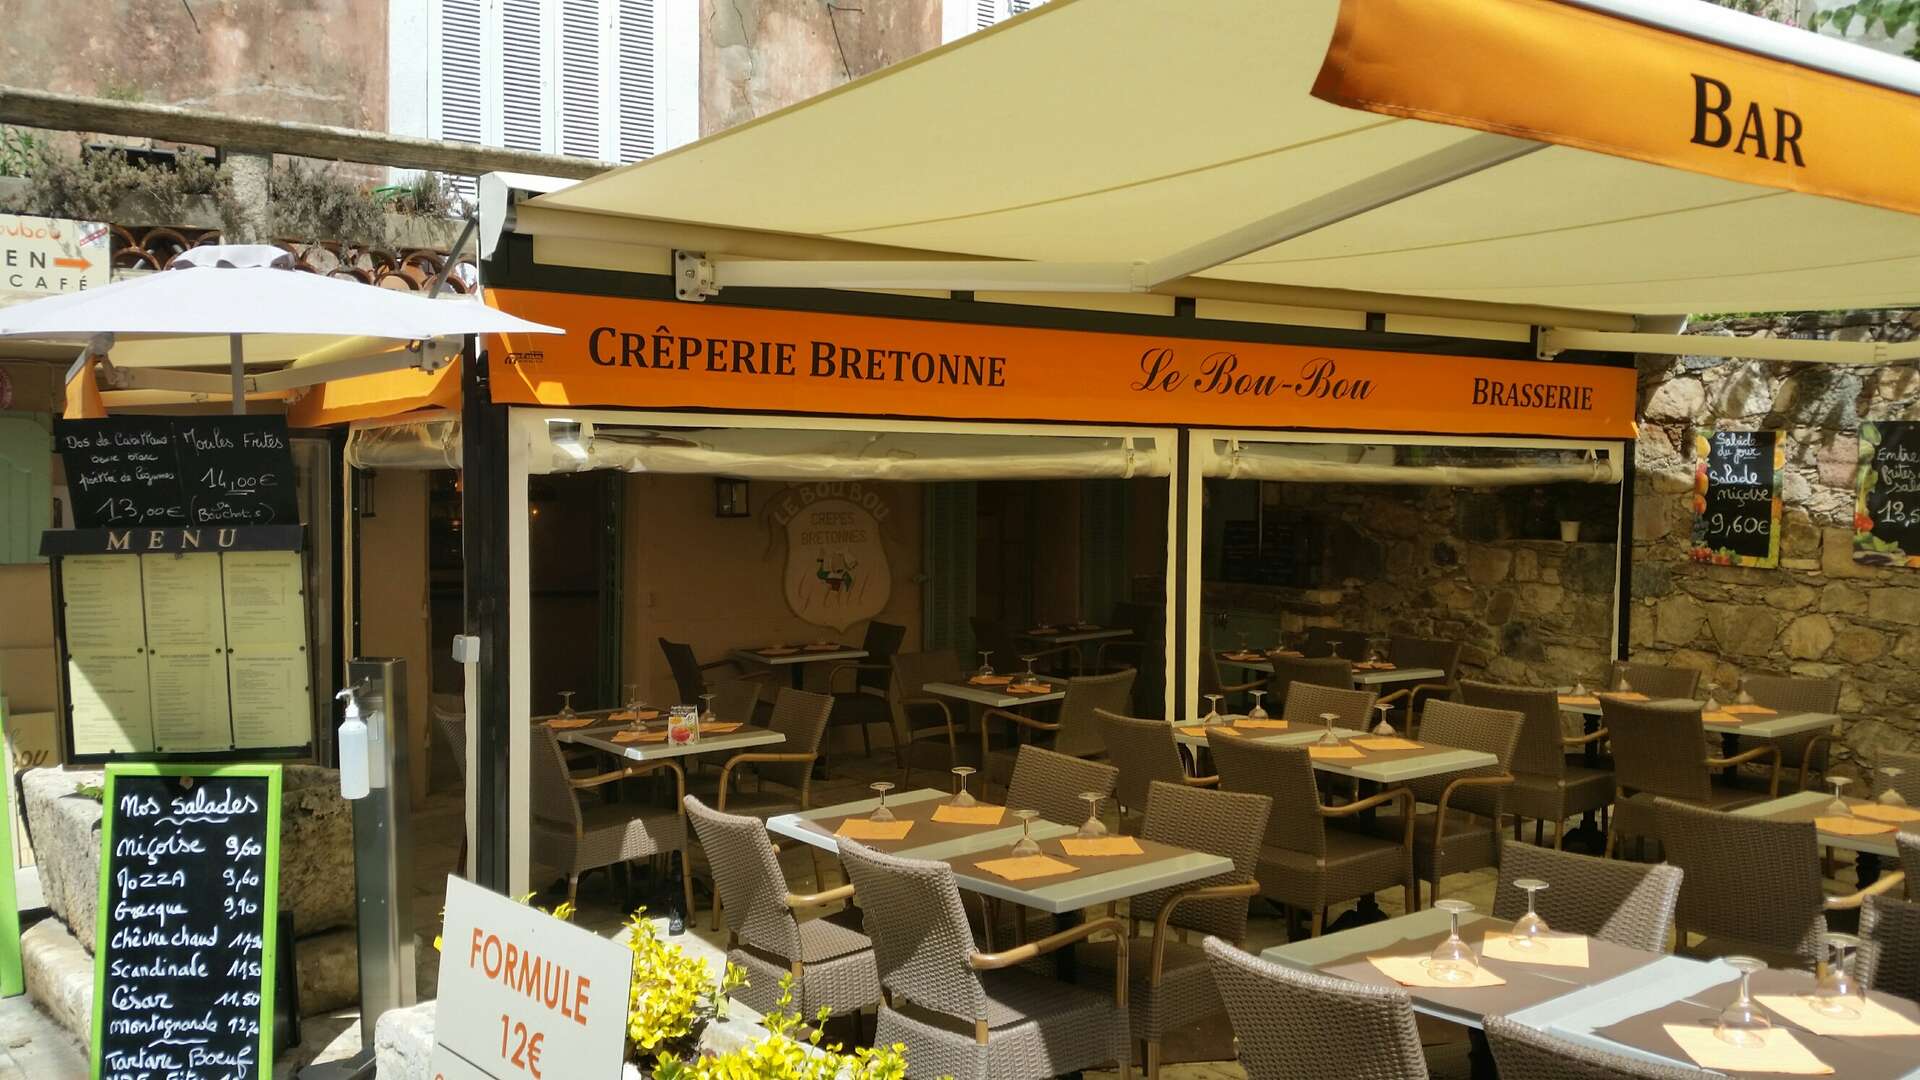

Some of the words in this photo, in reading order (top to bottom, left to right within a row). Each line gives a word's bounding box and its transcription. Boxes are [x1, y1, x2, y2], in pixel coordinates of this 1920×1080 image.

[1690, 73, 1806, 168] BAR
[9, 274, 88, 291] CAFÉ
[588, 325, 797, 377] CRÊPERIE
[809, 340, 1007, 387] BRETONNE
[1130, 347, 1189, 393] Le
[1194, 351, 1377, 400] Bou-Bou
[1472, 377, 1594, 410] BRASSERIE
[66, 435, 90, 449] Dos
[183, 428, 234, 456] Moules
[243, 432, 284, 449] Frites
[1717, 446, 1732, 457] du
[1733, 448, 1761, 465] jour
[200, 467, 279, 491] 14,00€
[1709, 464, 1762, 487] Salade
[96, 497, 185, 523] 13,00€
[1710, 512, 1769, 536] 9,60€
[106, 528, 237, 550] MENU
[225, 834, 263, 863] 9,60
[222, 868, 260, 893] 9,60
[114, 901, 189, 928] Grecque
[224, 896, 258, 920] 9,90
[170, 924, 219, 948] chaud
[469, 927, 591, 1026] FORMULE
[111, 984, 174, 1011] César
[105, 1047, 183, 1071] Tartare
[501, 1014, 545, 1080] 12€
